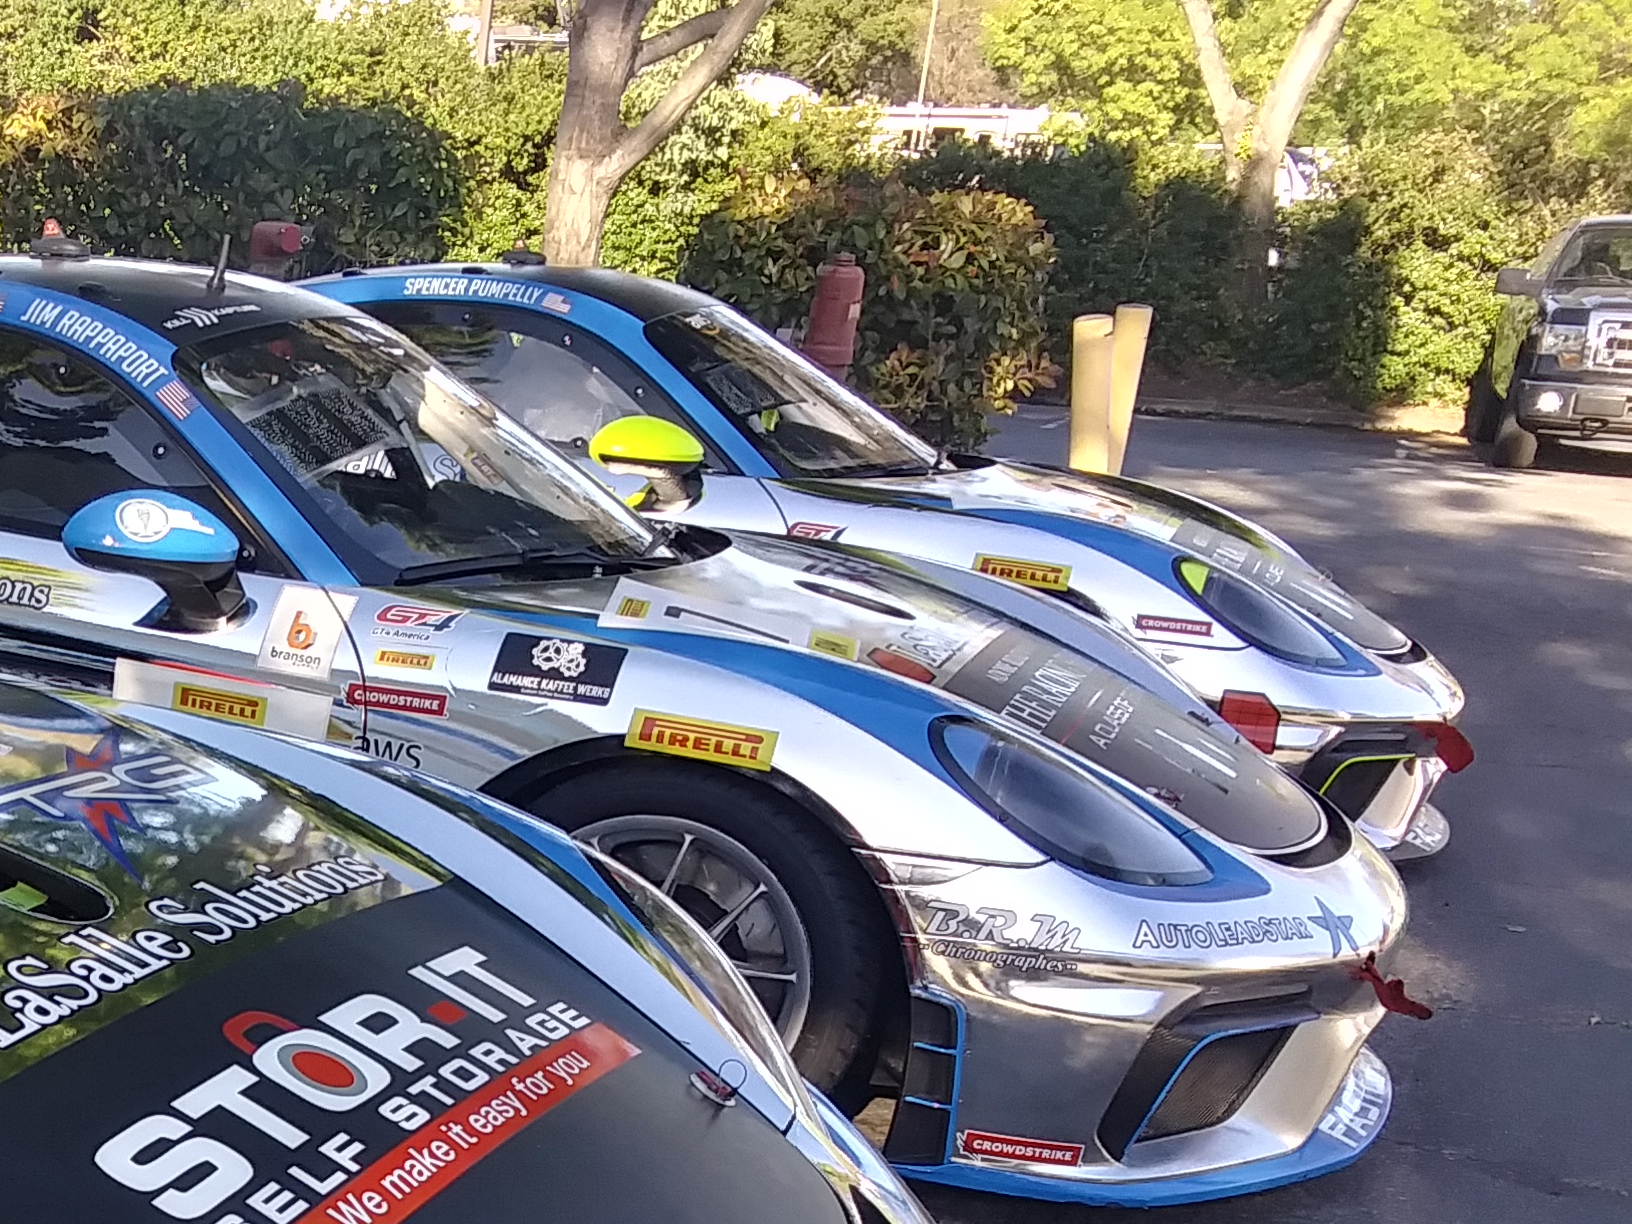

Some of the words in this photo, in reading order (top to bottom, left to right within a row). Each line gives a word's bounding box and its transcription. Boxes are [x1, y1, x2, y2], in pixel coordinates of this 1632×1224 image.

[403, 278, 469, 296] SPENCER
[468, 279, 543, 304] PUMPELLY
[20, 298, 63, 328] JIM
[55, 309, 169, 388] RAPPAPORT
[980, 557, 1063, 584] PIRELLI
[392, 629, 430, 640] America
[1141, 618, 1208, 633] CROWDSTRIKE
[270, 646, 321, 666] branson
[380, 650, 430, 667] PIRELLI
[491, 672, 541, 689] ALAMANCE
[540, 678, 576, 694] KAFFEE
[577, 683, 610, 698] WERKS
[179, 687, 260, 721] PIRELLI
[354, 689, 440, 711] CROWDSTRIKE
[638, 716, 764, 760] PIRELLI
[353, 734, 423, 769] aws
[148, 854, 386, 945] Solutions
[377, 1001, 593, 1131] STORAGE
[382, 1134, 456, 1199] make
[448, 1119, 479, 1147] it
[468, 1090, 529, 1136] easy
[511, 1066, 552, 1102] for
[545, 1049, 592, 1088] you
[973, 1139, 1074, 1161] CROWDSTRIKE
